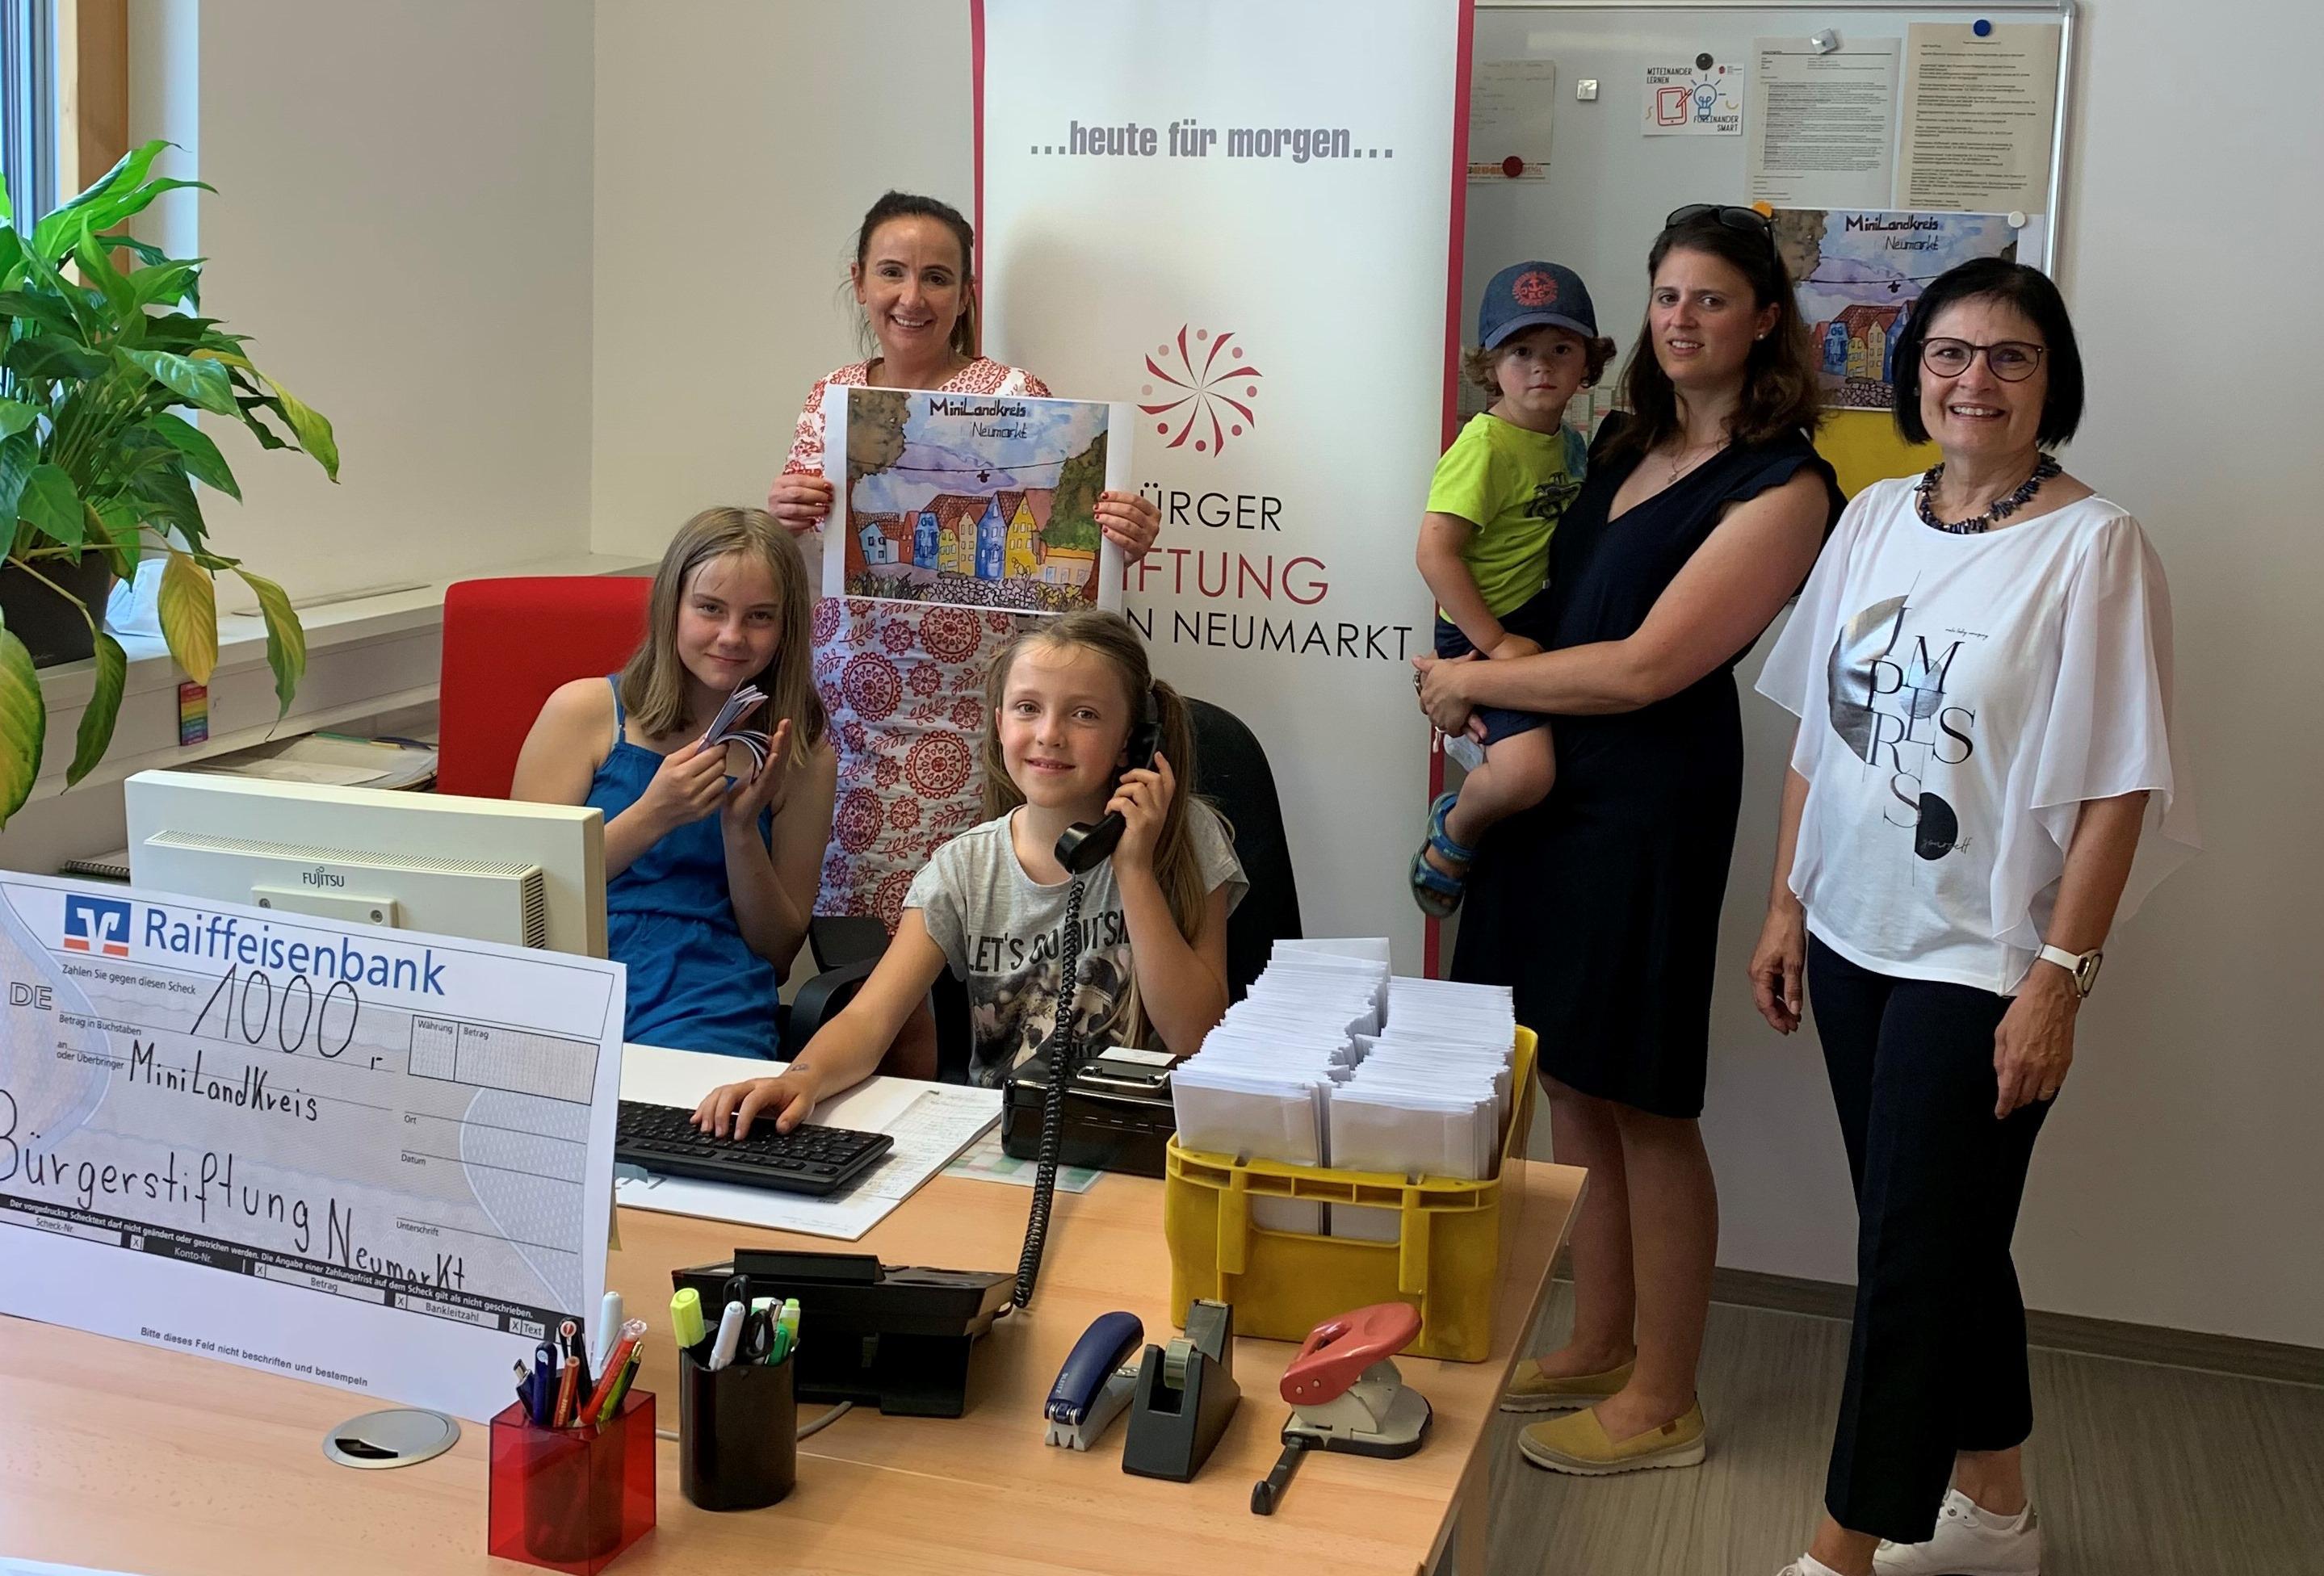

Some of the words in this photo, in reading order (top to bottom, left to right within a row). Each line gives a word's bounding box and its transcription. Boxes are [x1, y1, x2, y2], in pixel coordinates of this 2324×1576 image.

[1647, 68, 1692, 76] MITEINANDER
[1168, 119, 1217, 157] für
[1173, 610, 1412, 661] NEUMARKT
[303, 866, 345, 888] FUJITSU
[145, 907, 446, 996] Raiffeisenbank
[62, 964, 92, 978] Zahlen
[94, 969, 107, 979] Sie
[109, 973, 136, 986] gegen
[138, 977, 166, 990] diesen
[168, 981, 196, 995] Scheck
[10, 982, 52, 1011] DE
[59, 1014, 86, 1028] Betrag
[97, 1021, 141, 1037] Buchstaben
[417, 1020, 453, 1034] Währung
[464, 1026, 489, 1040] Betrag
[57, 1041, 68, 1049] an
[57, 1051, 75, 1060] oder
[404, 1114, 417, 1125] Ort
[401, 1153, 426, 1166] Datum
[396, 1221, 439, 1237] Unterschrift
[10, 1199, 23, 1208] Der
[24, 1202, 68, 1218] vorgedruckte
[69, 1211, 106, 1226] Schecktext
[107, 1219, 122, 1230] darf
[124, 1223, 141, 1234] nicht
[143, 1226, 174, 1242] geändert
[175, 1234, 192, 1244] oder
[194, 1238, 229, 1253] gestrichen
[261, 1252, 274, 1263] Die
[275, 1255, 303, 1269] Angabe
[304, 1263, 324, 1274] einer
[325, 1266, 372, 1285] Zahlungsfrist
[374, 1277, 387, 1289] auf
[388, 1280, 405, 1292] dem
[407, 1284, 434, 1298] Scheck
[434, 1291, 448, 1301] gilt
[450, 1293, 461, 1304] als
[463, 1297, 483, 1309] nicht
[311, 1276, 338, 1293] Betrag
[426, 1302, 480, 1323] Bankleitzahl
[523, 1322, 543, 1336] Text
[141, 1327, 161, 1339] Bitte
[164, 1332, 193, 1347] dieses
[195, 1339, 215, 1352] Feld
[218, 1344, 240, 1357] nicht
[242, 1349, 292, 1369] beschriften
[295, 1363, 313, 1374] und
[315, 1365, 368, 1387] bestempeln
